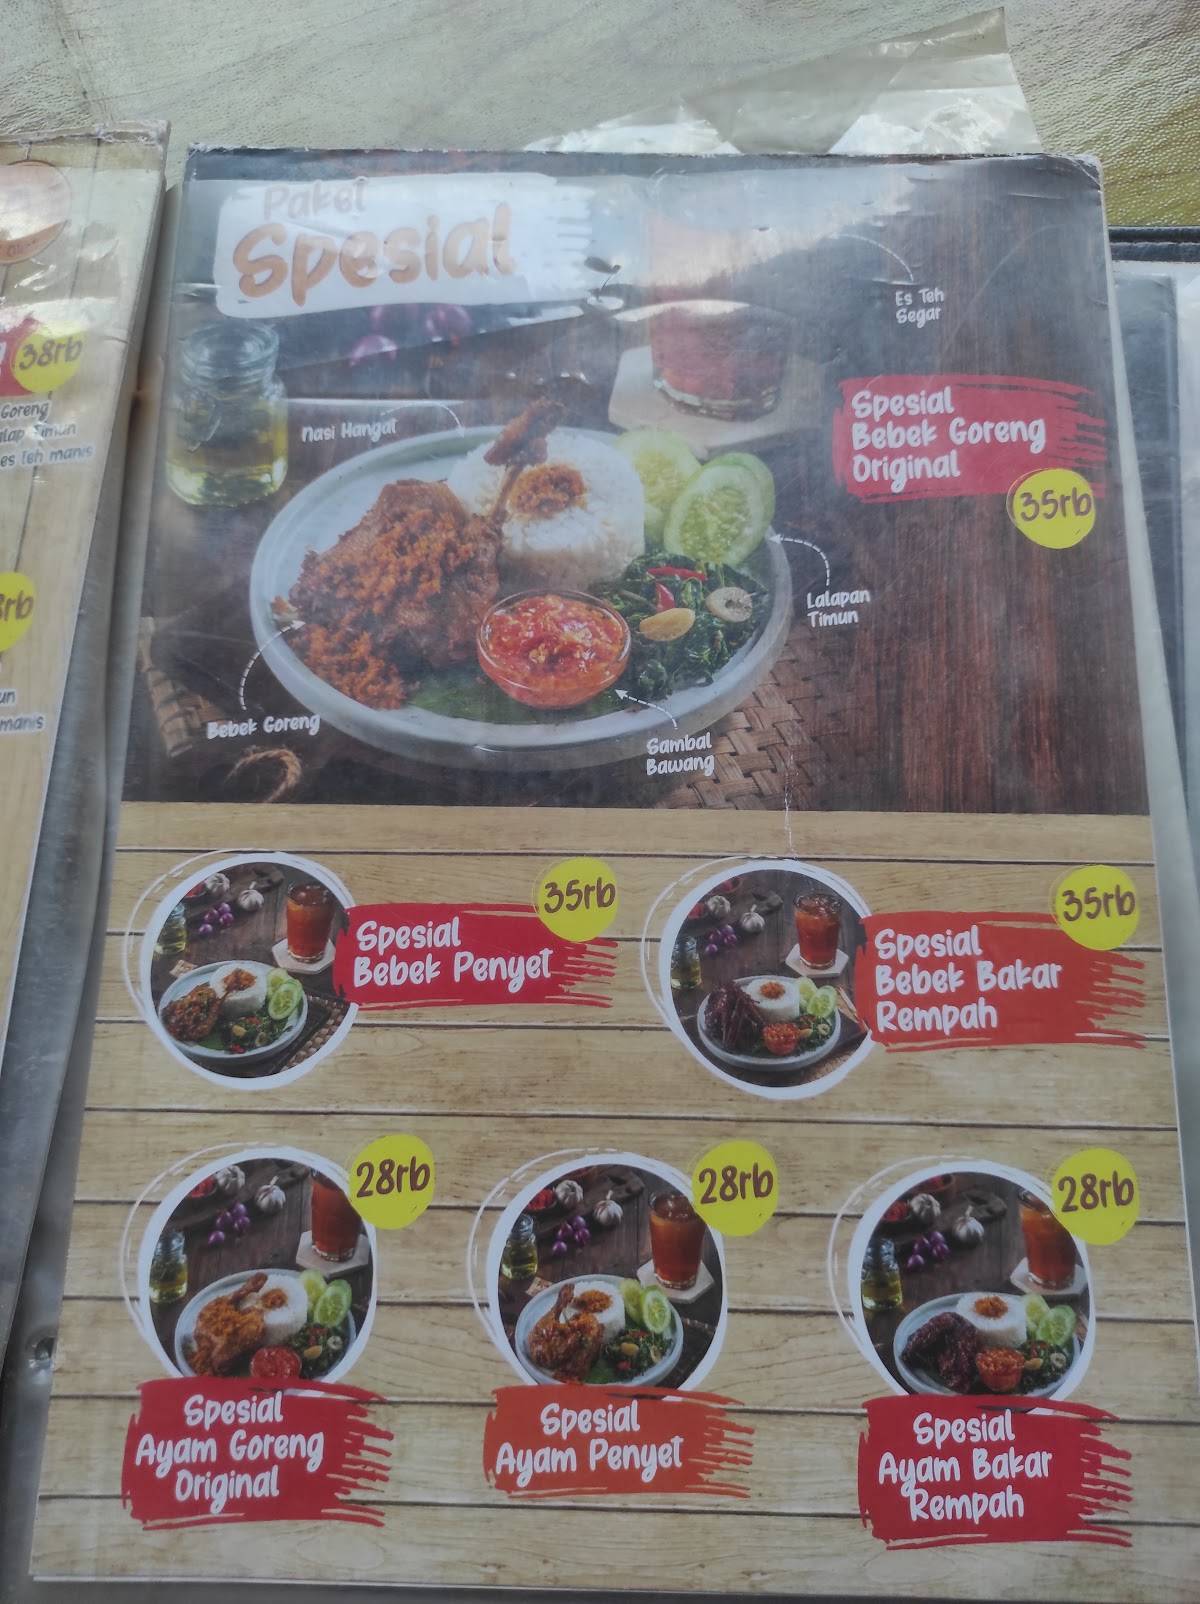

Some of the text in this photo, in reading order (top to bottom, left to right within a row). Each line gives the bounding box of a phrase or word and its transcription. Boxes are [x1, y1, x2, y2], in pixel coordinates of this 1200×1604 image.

[264, 175, 368, 220] Paket
[232, 202, 518, 306] Spesial
[895, 287, 945, 306] Es Teh
[896, 306, 943, 329] Segar
[19, 335, 83, 370] 38rb
[1, 402, 49, 422] Goreng
[851, 386, 955, 421] Spesial
[301, 416, 399, 444] Nasi Hangat
[851, 416, 1047, 454] Bebek Goreng
[0, 454, 16, 467] es
[852, 449, 961, 493] Original
[1019, 487, 1093, 523] 35rb
[806, 588, 871, 610] Lalapan
[807, 609, 859, 629] Timun
[0, 715, 44, 732] manis
[206, 712, 321, 740] Bebek Goreng
[646, 731, 713, 755] Sambal
[646, 754, 715, 777] Bawang
[543, 876, 617, 915] 35rb
[1061, 883, 1136, 922] 35rb
[355, 916, 462, 958] Spesial
[874, 924, 983, 964] Spesial
[353, 946, 555, 994] Bebek Penyet
[874, 958, 1063, 996] Bebek Bakar
[876, 997, 998, 1035] Rempah
[355, 1156, 431, 1198] 28rb
[698, 1162, 774, 1204] 28rb
[1057, 1171, 1135, 1213] 28rb
[183, 1390, 284, 1431] Spesial
[540, 1399, 641, 1440] Spesial
[912, 1408, 1016, 1449] Spesial
[135, 1430, 325, 1478] Ayam Goreng
[495, 1435, 685, 1488] Ayam Penyet
[878, 1446, 1053, 1498] Ayam Bakar
[174, 1465, 280, 1515] Original
[909, 1485, 1025, 1525] Rempah
